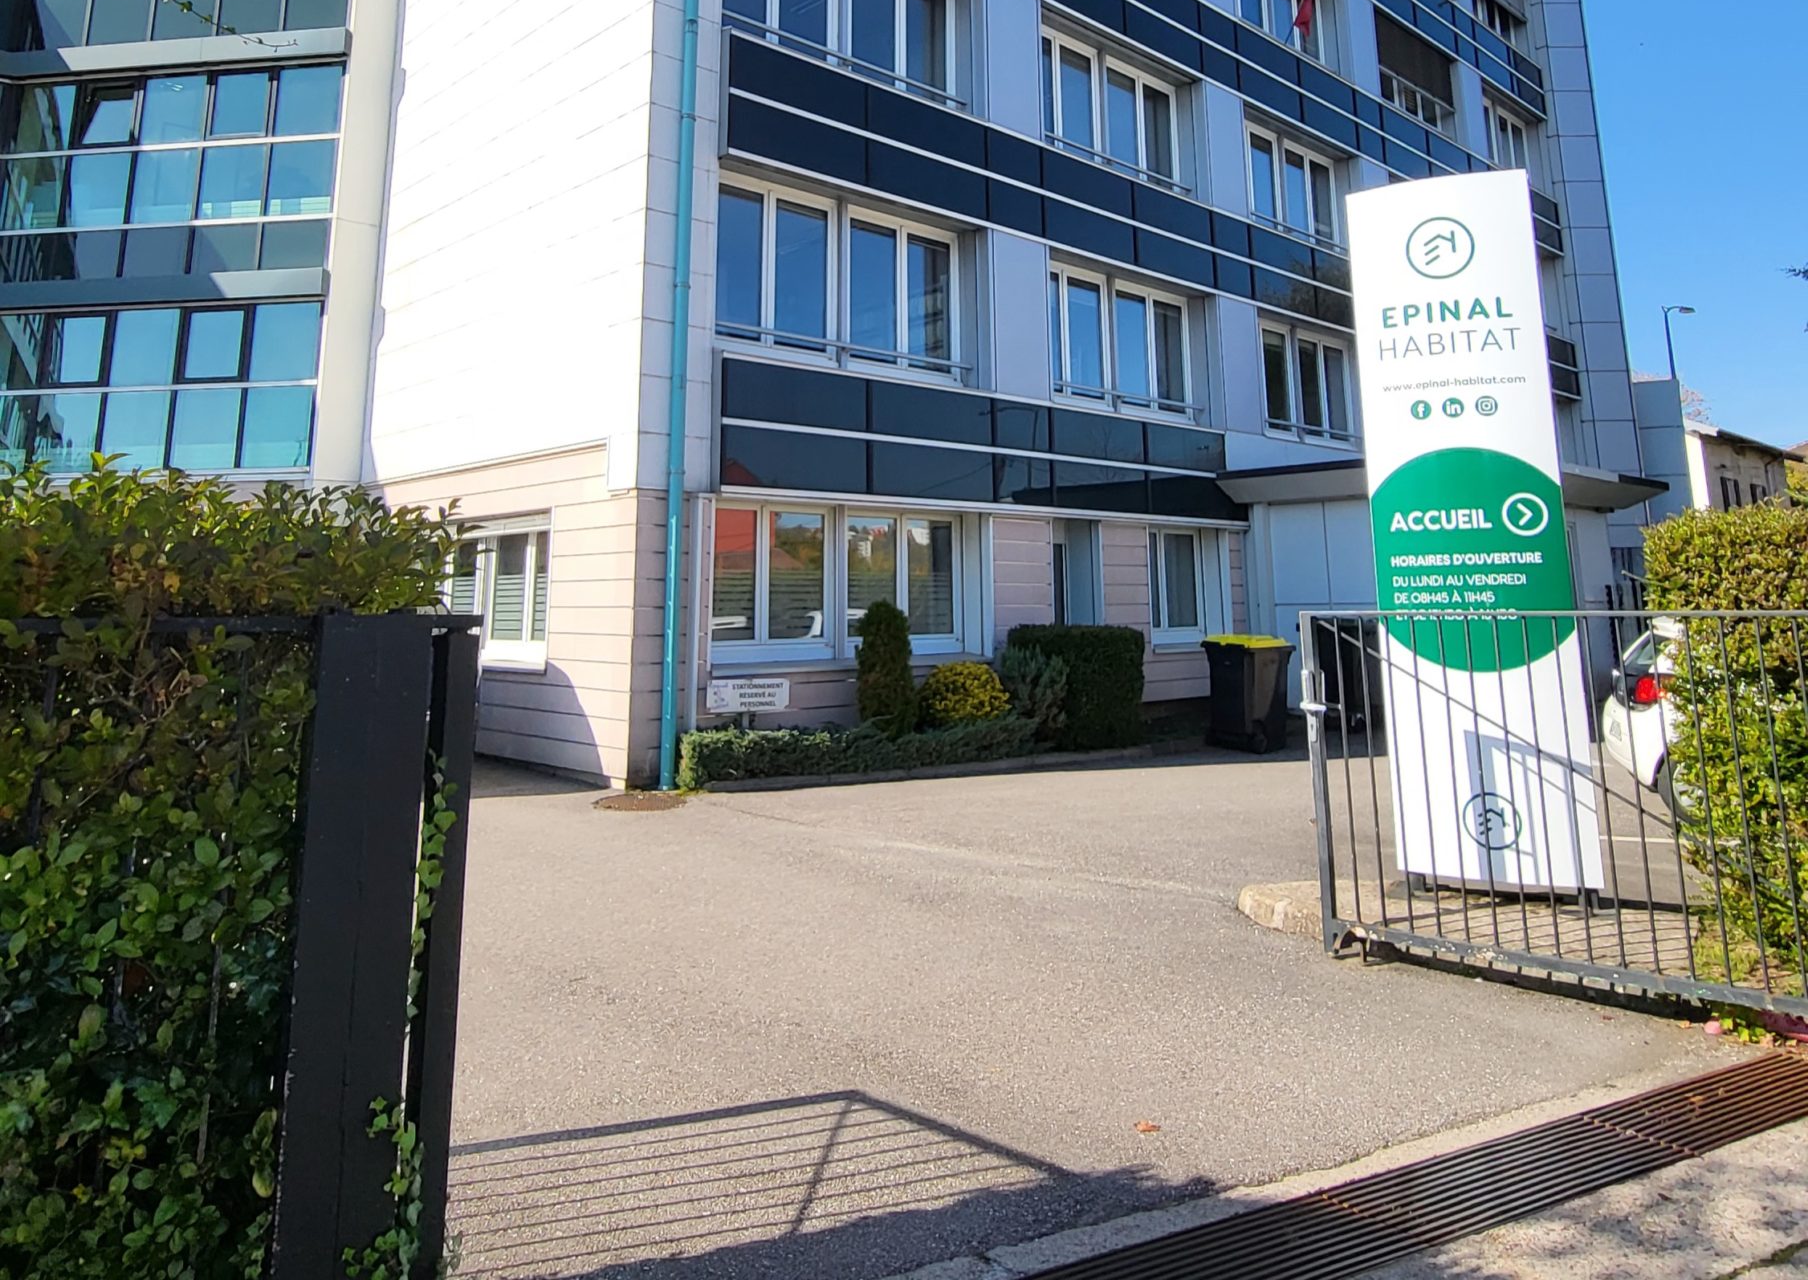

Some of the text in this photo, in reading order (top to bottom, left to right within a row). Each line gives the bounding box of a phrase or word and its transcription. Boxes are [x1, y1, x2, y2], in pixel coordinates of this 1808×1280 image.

[1382, 296, 1513, 329] EPINAL
[1378, 327, 1522, 361] HABITAT
[1382, 375, 1527, 392] www.epinal-habitat.com
[1390, 508, 1492, 532] ACCUEIL
[1390, 551, 1543, 568] HORAIRES D'OUVERTURE
[1392, 573, 1527, 588] DU LUNDI AU VENDREDI
[1394, 588, 1496, 605] DE 08H45 À 11H45
[732, 682, 784, 691] STATIONNEMENT
